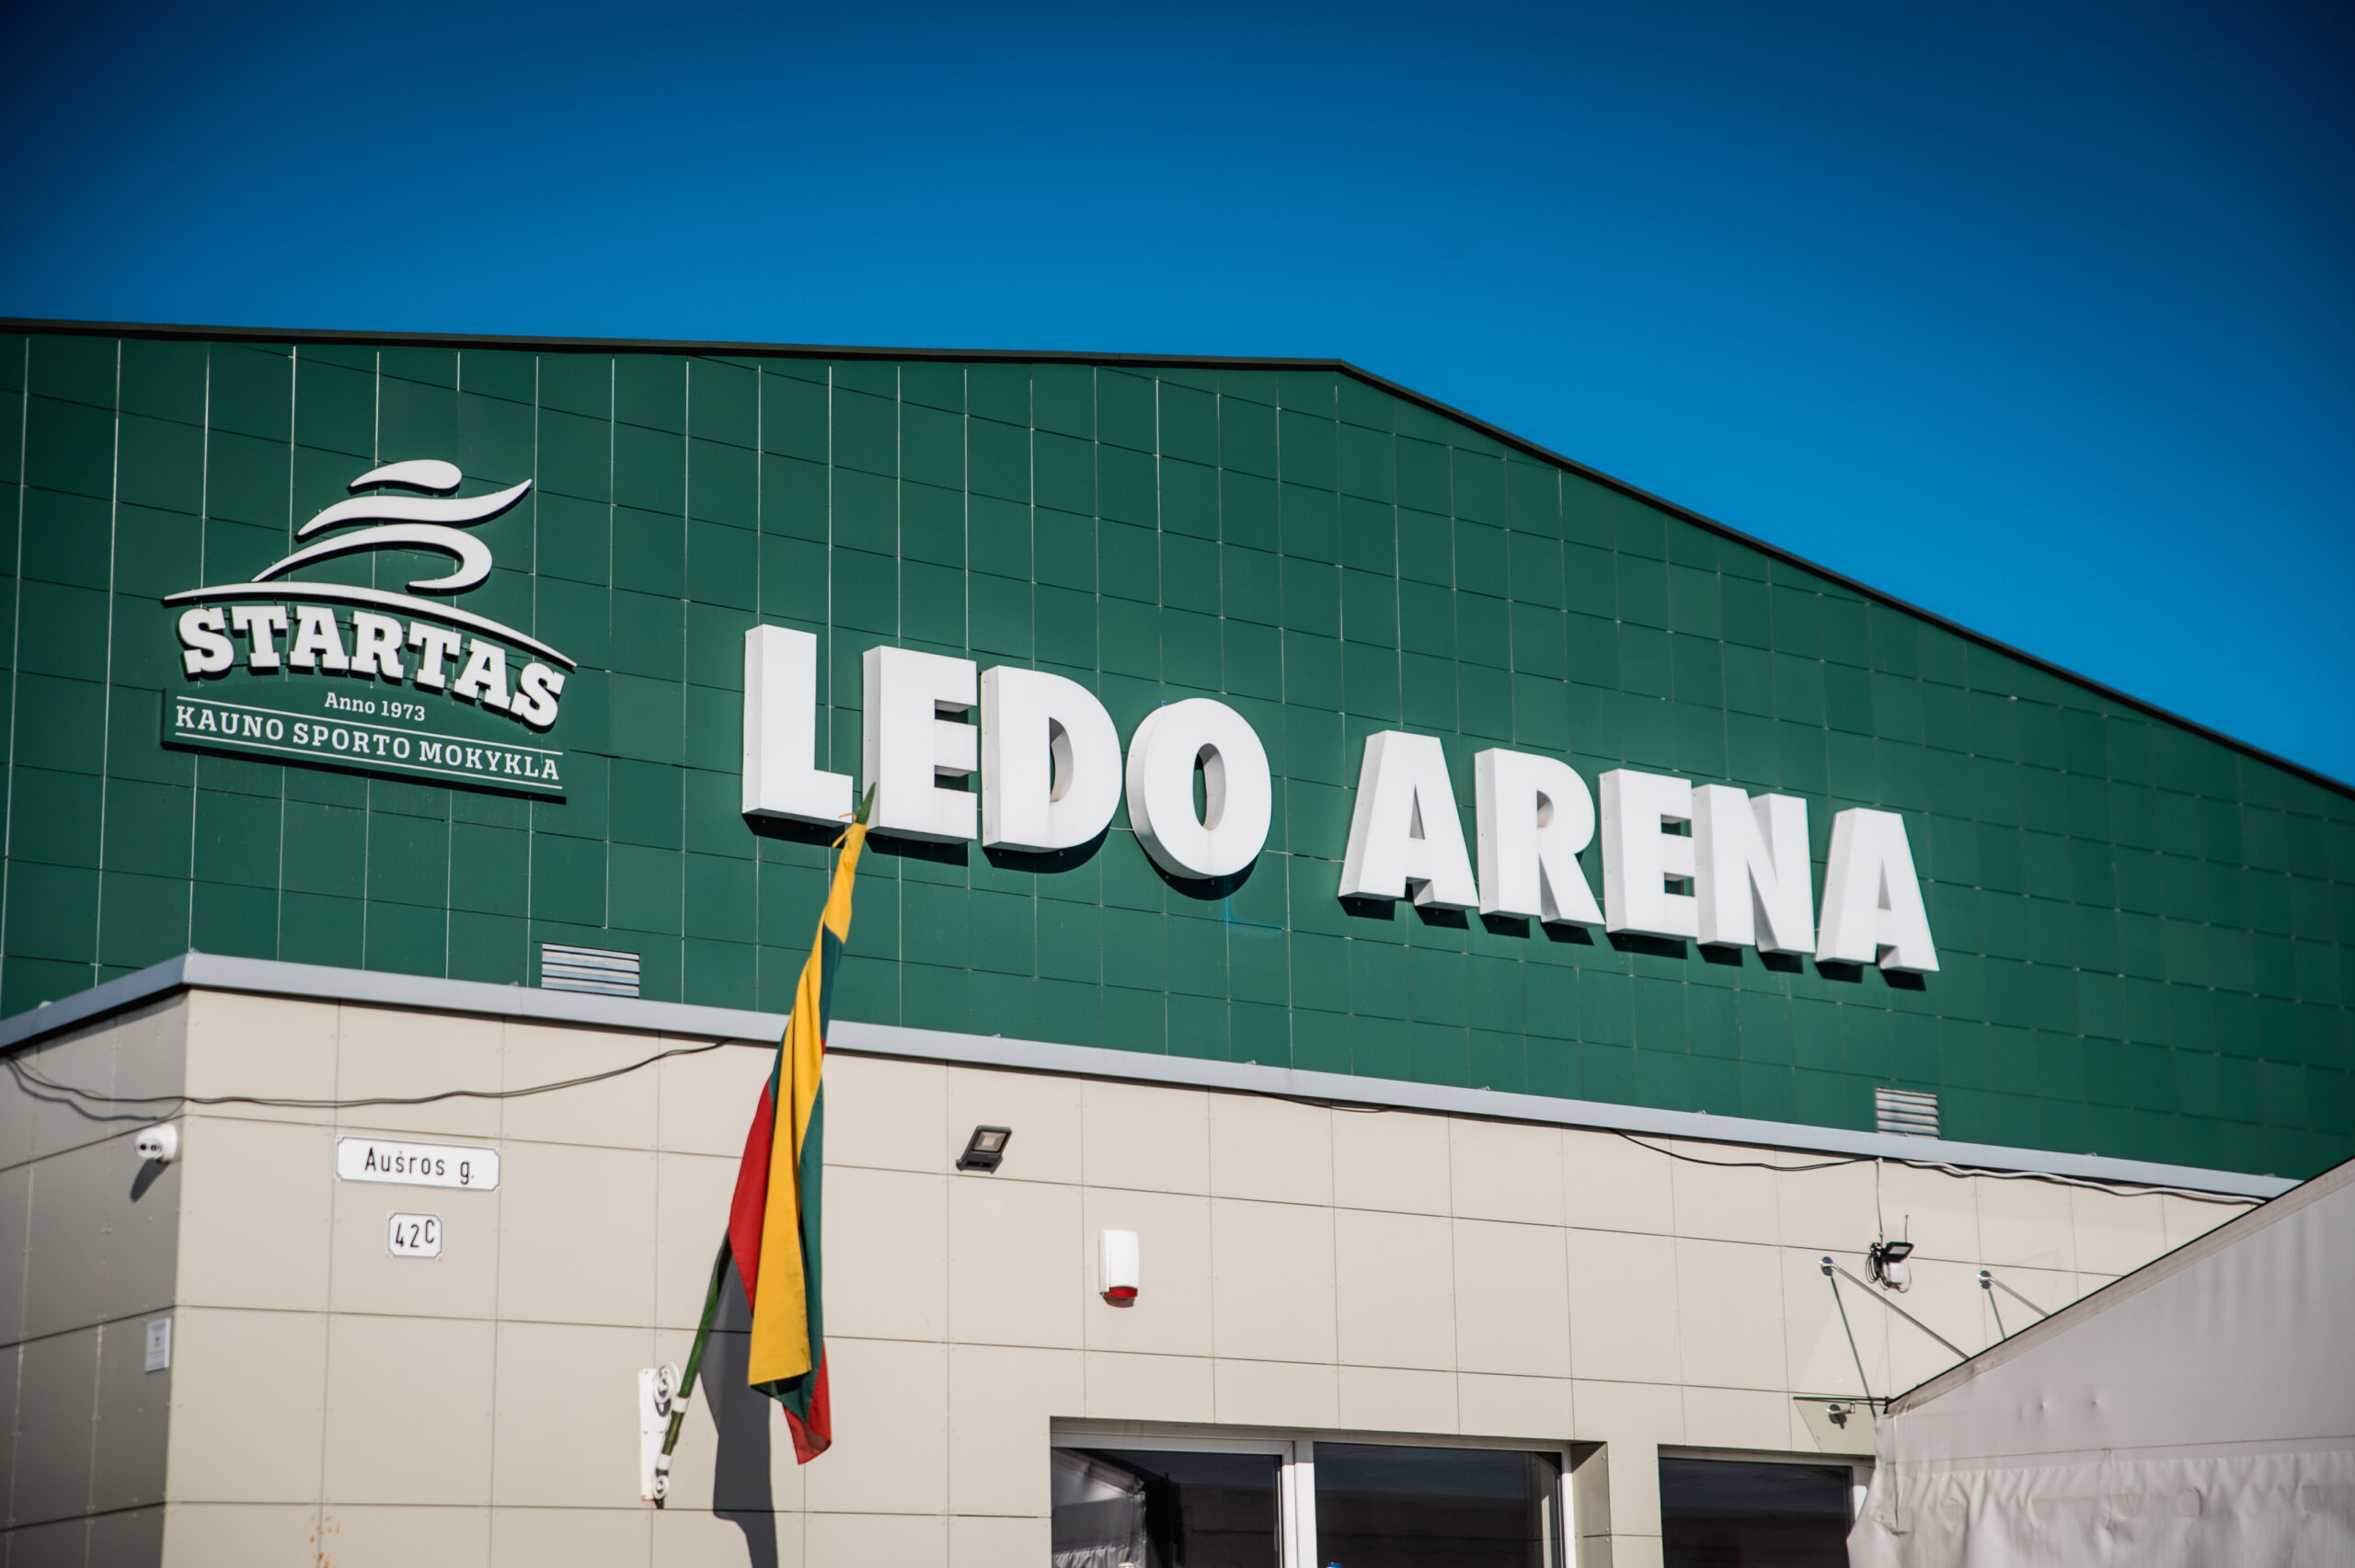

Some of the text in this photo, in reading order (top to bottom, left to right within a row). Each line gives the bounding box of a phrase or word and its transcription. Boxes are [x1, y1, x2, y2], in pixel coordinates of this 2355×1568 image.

[178, 605, 566, 727] STARTAS
[324, 692, 426, 722] Anno 1973
[175, 705, 560, 781] KAUNO SPORTO MOKYKLA
[741, 624, 1940, 974] LEDO ARENA
[459, 1160, 476, 1185] g.
[395, 1219, 435, 1248] 42C
